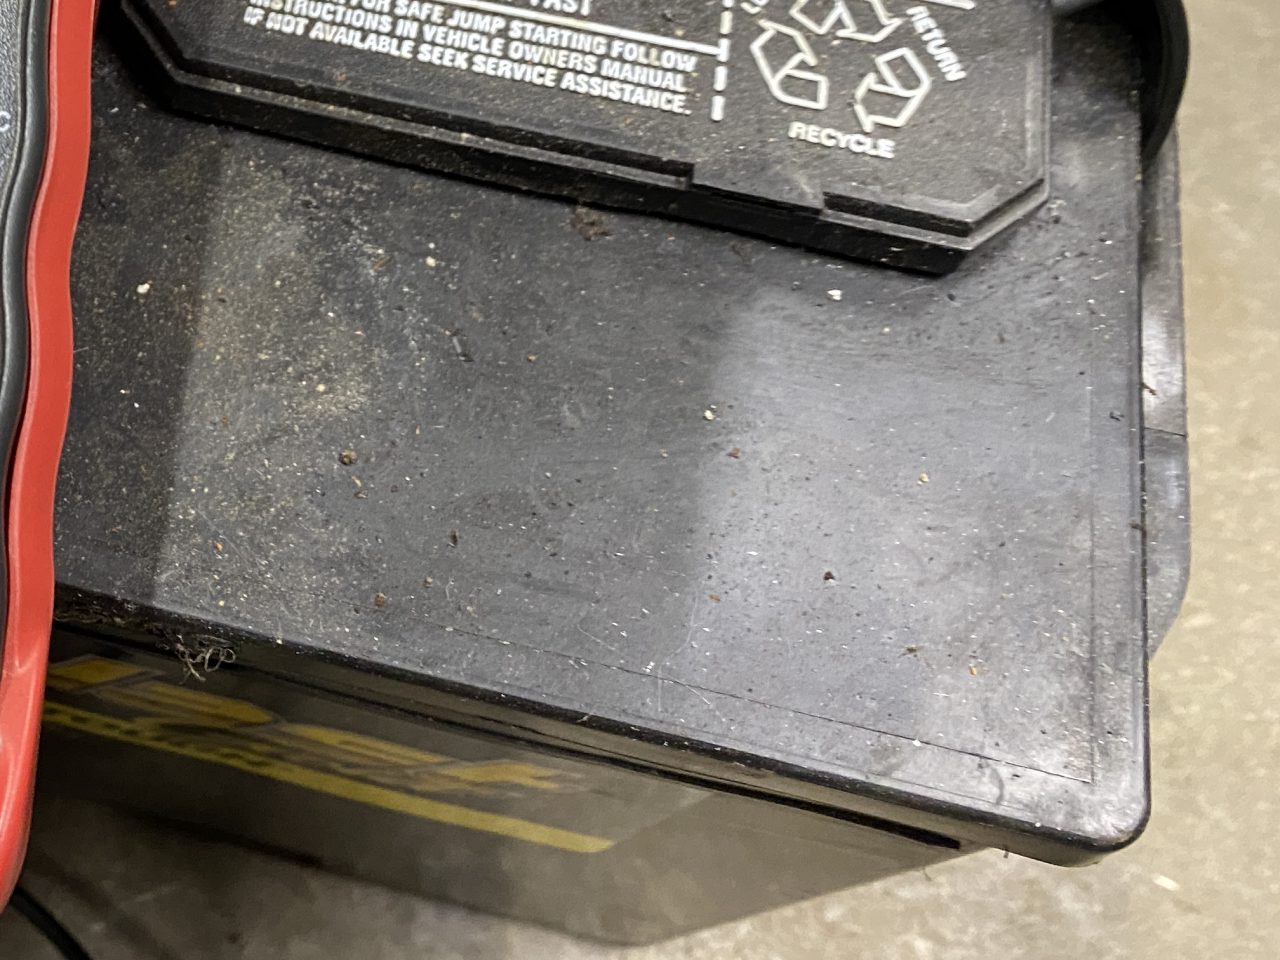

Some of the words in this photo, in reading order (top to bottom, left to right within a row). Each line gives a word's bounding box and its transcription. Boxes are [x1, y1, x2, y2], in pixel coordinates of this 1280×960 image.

[244, 6, 265, 26] IF
[266, 12, 309, 35] NOT
[310, 21, 416, 59] AVAILABLE
[417, 43, 468, 70] SEEK
[472, 55, 558, 87] SERVICE
[560, 71, 692, 115] ASSISTANCE.
[396, 19, 418, 38] IN
[423, 23, 504, 57] VEHICLE
[509, 41, 597, 74] OWNERS
[601, 59, 688, 92] MANUAL
[446, 10, 505, 35] JUMP
[509, 19, 607, 55] STARTING
[611, 40, 698, 72] FOLLOW
[906, 5, 967, 81] RETURN
[788, 121, 895, 159] RECYCLE
